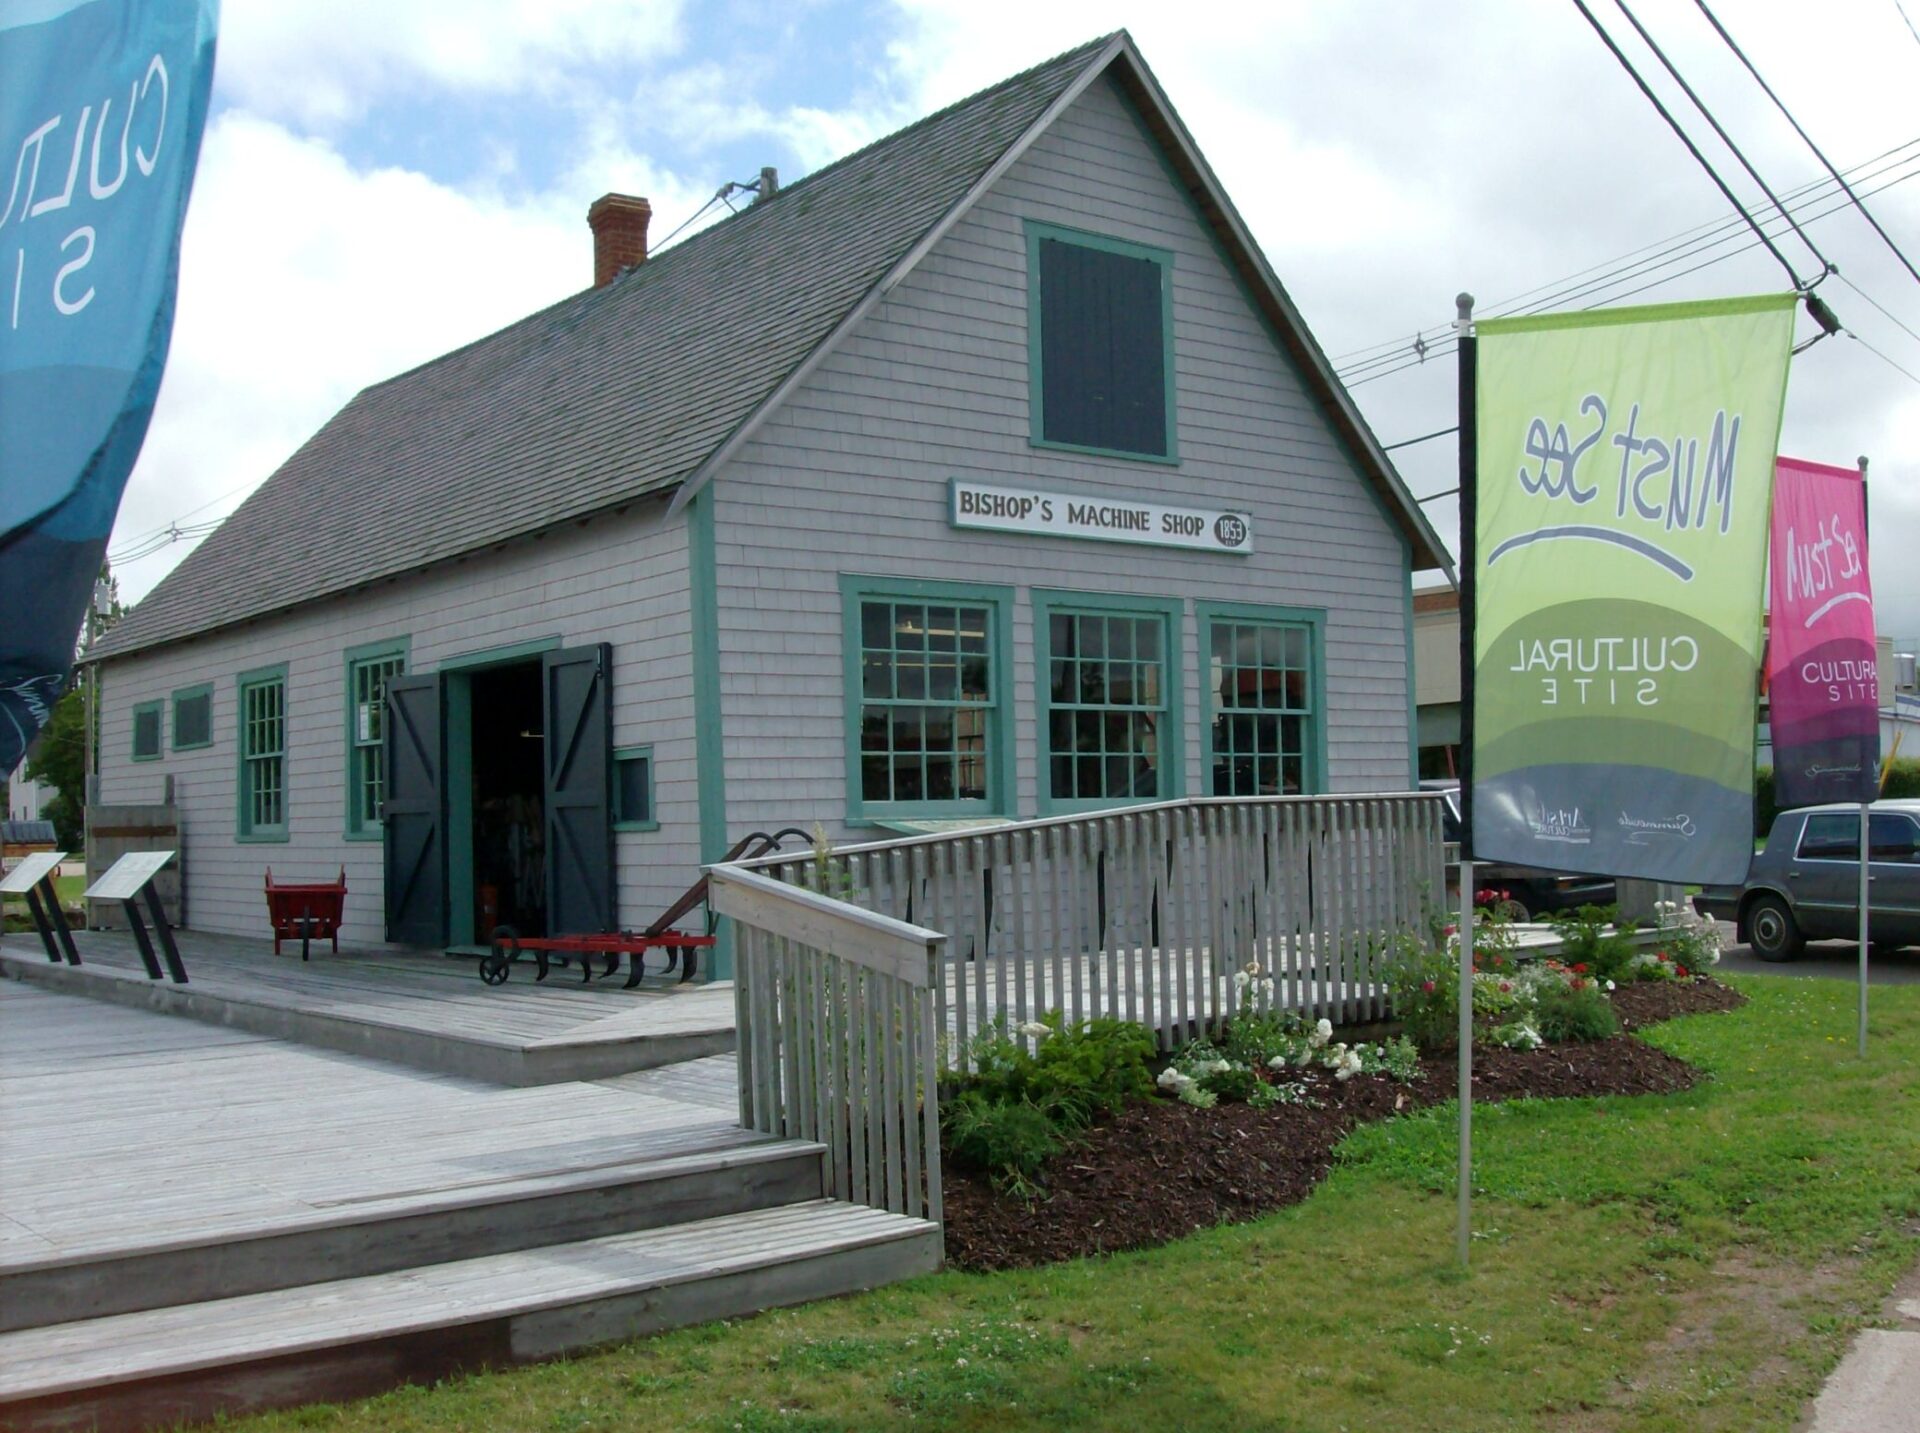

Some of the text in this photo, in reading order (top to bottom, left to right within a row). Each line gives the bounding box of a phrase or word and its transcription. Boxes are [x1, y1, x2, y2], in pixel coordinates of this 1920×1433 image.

[959, 490, 1205, 536] BISHOP'S MACHINE SHOP
[1219, 519, 1243, 541] 1853
[1828, 684, 1877, 702] SITE
